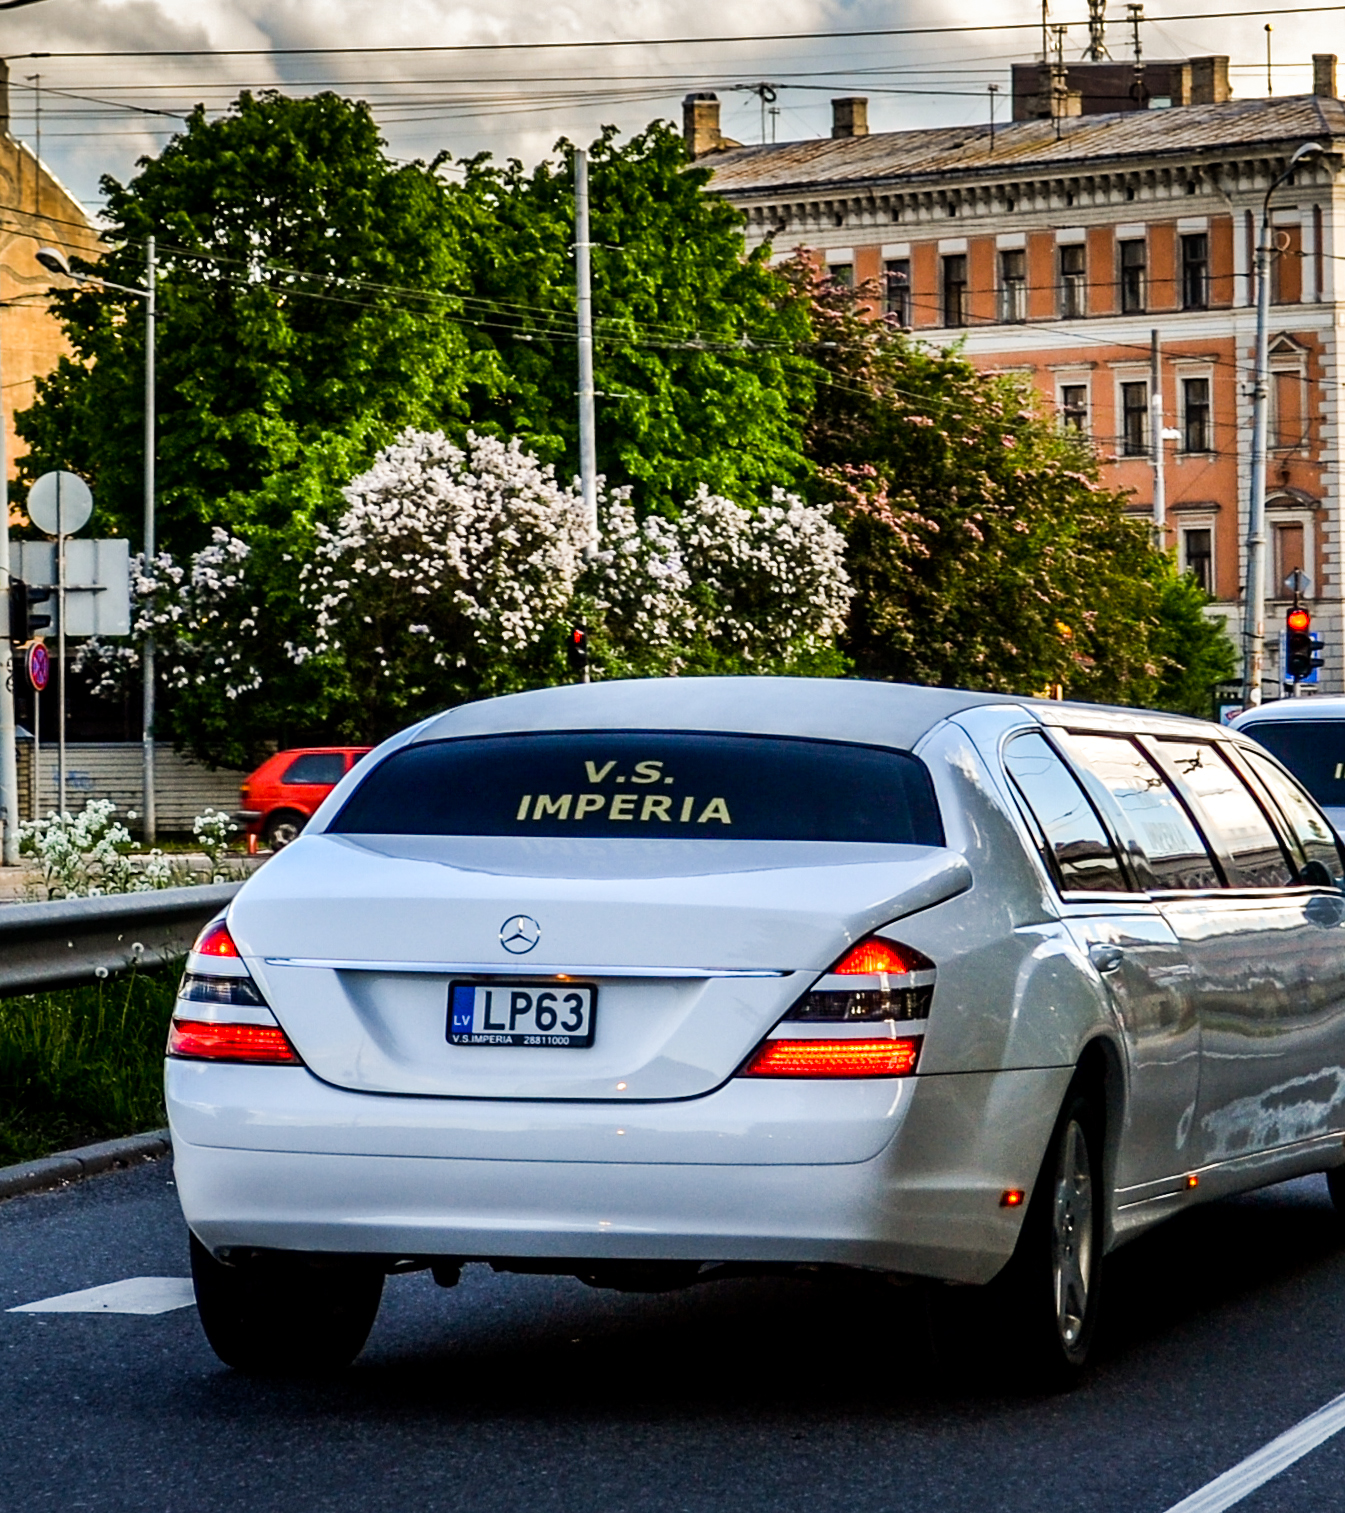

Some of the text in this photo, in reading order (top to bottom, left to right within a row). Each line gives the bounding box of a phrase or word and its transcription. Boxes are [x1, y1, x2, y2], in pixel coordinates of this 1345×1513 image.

[584, 760, 675, 784] V.S.
[516, 794, 732, 824] IMPERIA
[453, 1015, 471, 1026] LV
[483, 991, 584, 1032] LP63
[523, 1036, 570, 1045] 28811000
